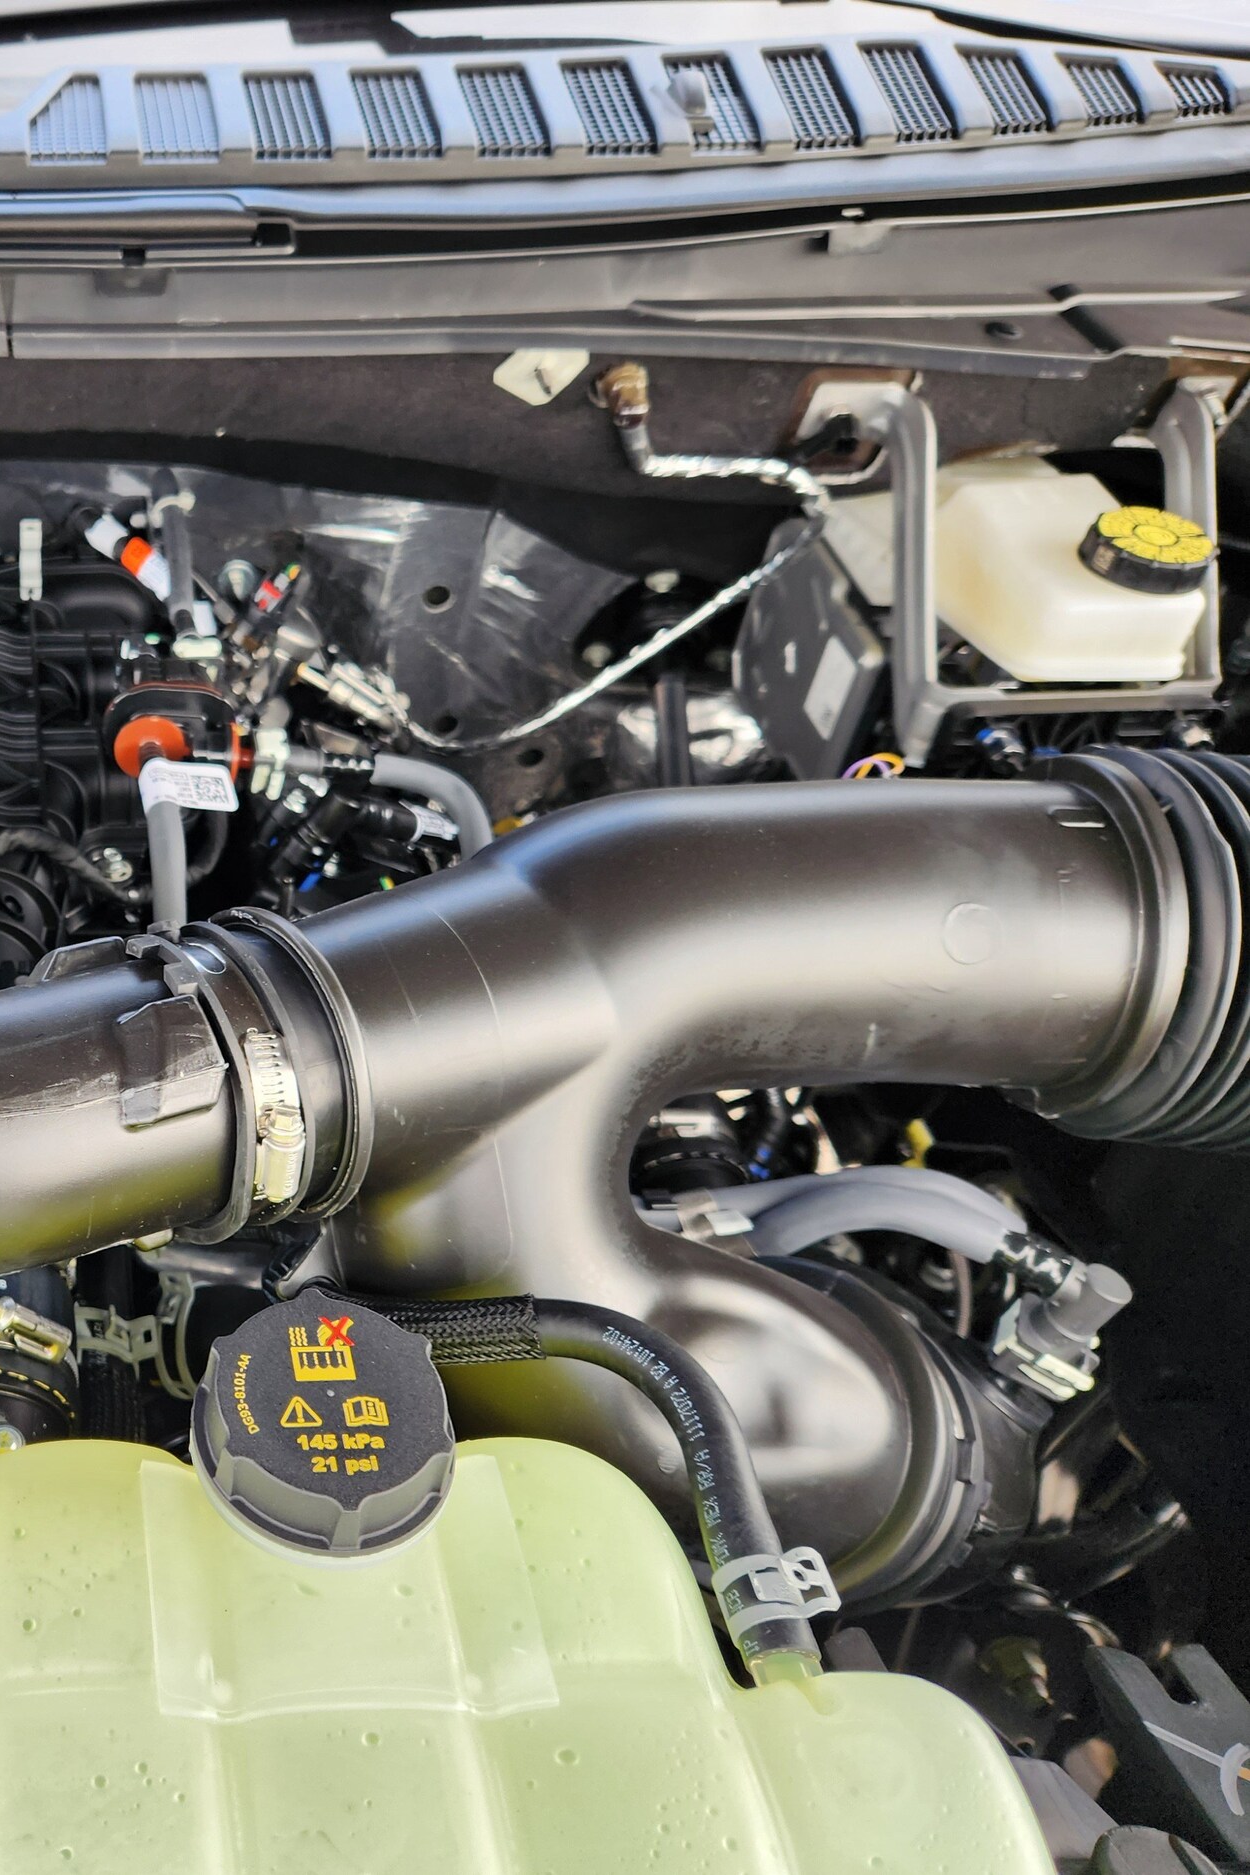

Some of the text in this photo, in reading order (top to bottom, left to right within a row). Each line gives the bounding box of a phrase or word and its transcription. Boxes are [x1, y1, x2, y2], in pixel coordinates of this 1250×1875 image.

[602, 1326, 656, 1367] 10:24:02
[232, 1353, 260, 1435] DG93-8101-AA
[296, 1433, 386, 1450] 145 kPa
[311, 1455, 379, 1476] 21 psi
